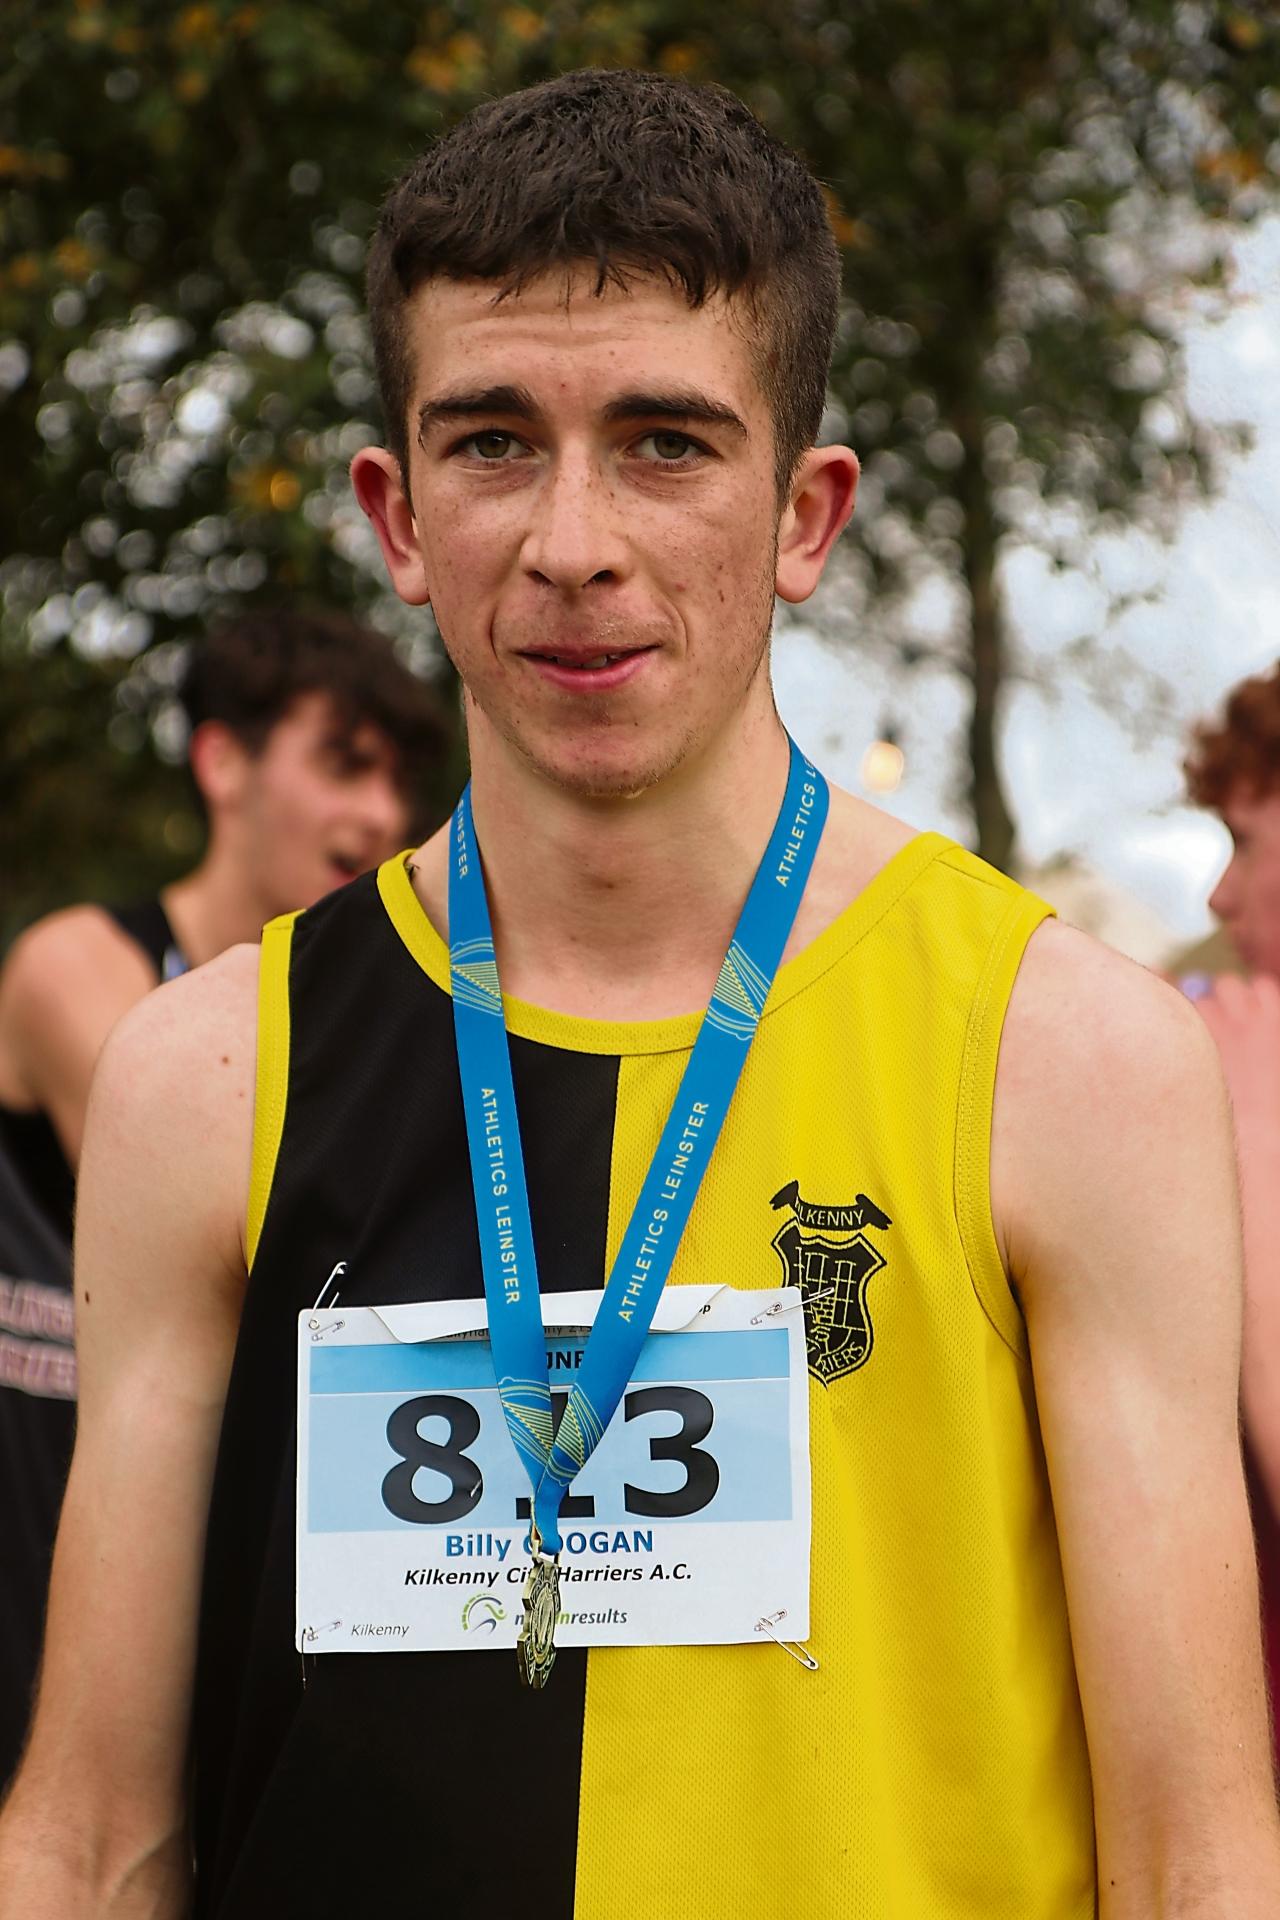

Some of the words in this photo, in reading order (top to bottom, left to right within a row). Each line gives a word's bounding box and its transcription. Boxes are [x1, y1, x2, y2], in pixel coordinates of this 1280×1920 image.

[457, 799, 468, 880] EINSTER
[776, 782, 816, 888] ATHLETICS
[481, 1087, 508, 1197] ATHLETICS
[495, 1205, 520, 1305] LEINSTER
[618, 1208, 668, 1323] ATHLETICS
[660, 1101, 709, 1200] LEINSTER
[404, 1569, 499, 1588] Kilkenny
[507, 1567, 532, 1584] Ci
[557, 1565, 643, 1582] Harriers
[650, 1563, 693, 1581] A.C.
[446, 1534, 512, 1562] Billy
[523, 1530, 653, 1555] OGAN
[351, 1623, 410, 1638] Kilkenny
